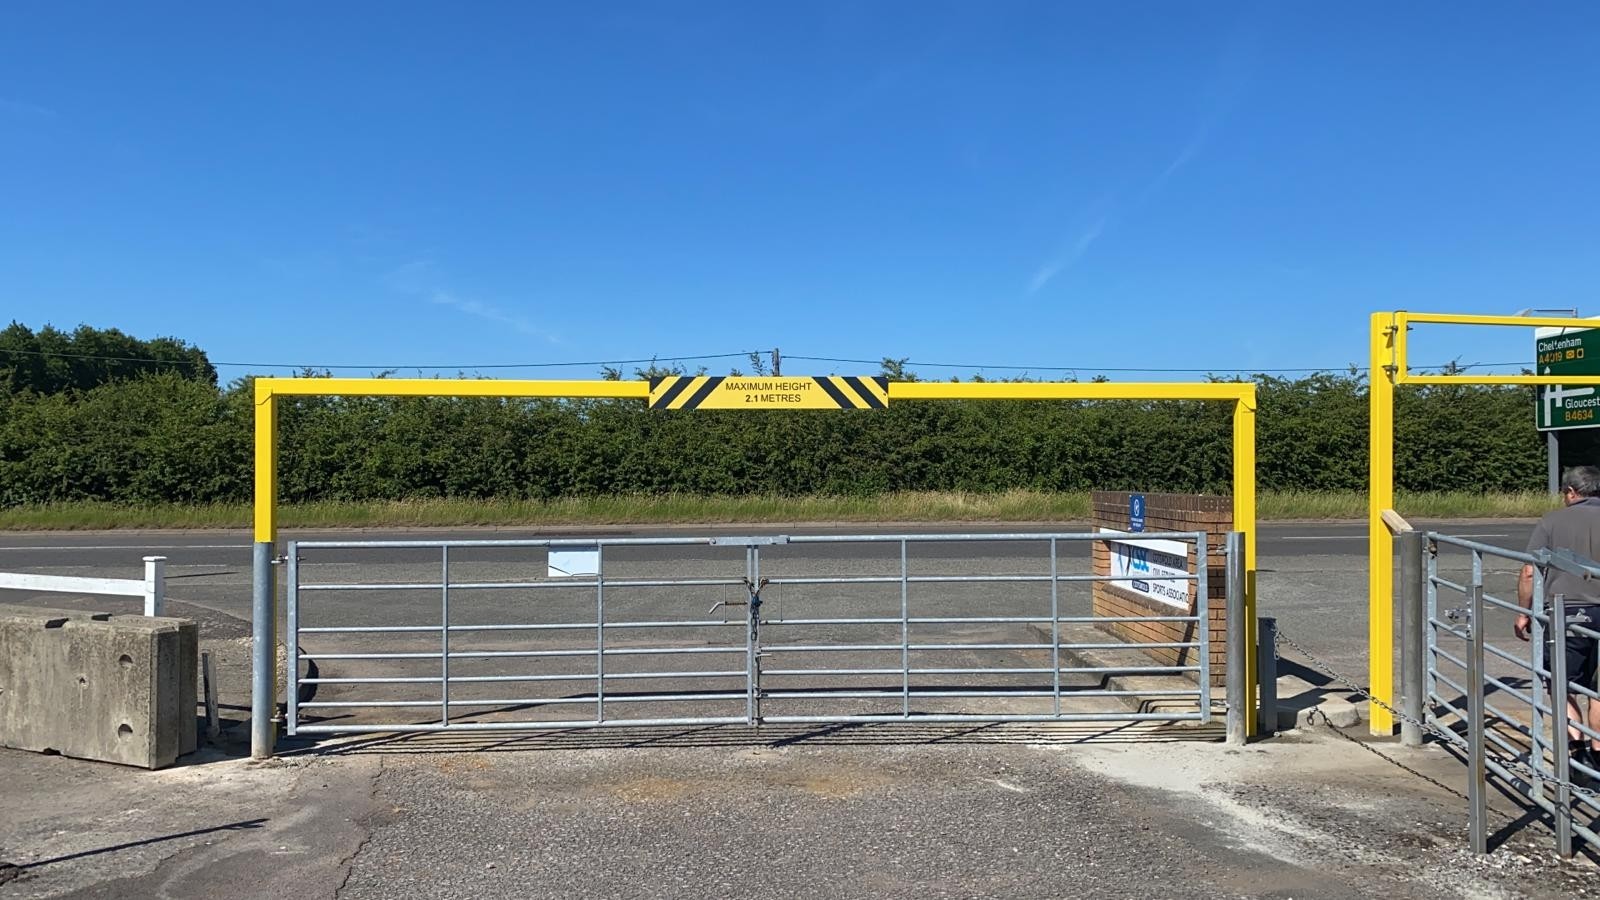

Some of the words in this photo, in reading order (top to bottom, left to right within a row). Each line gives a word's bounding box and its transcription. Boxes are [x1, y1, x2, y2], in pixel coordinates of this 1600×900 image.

[1538, 338, 1582, 352] Cheltenham
[1538, 351, 1563, 364] A4019
[725, 382, 773, 391] MAXIMUM
[775, 382, 812, 391] HEIGHT
[745, 394, 758, 402] 2.1
[760, 394, 801, 402] METRES
[1565, 409, 1593, 421] B4634
